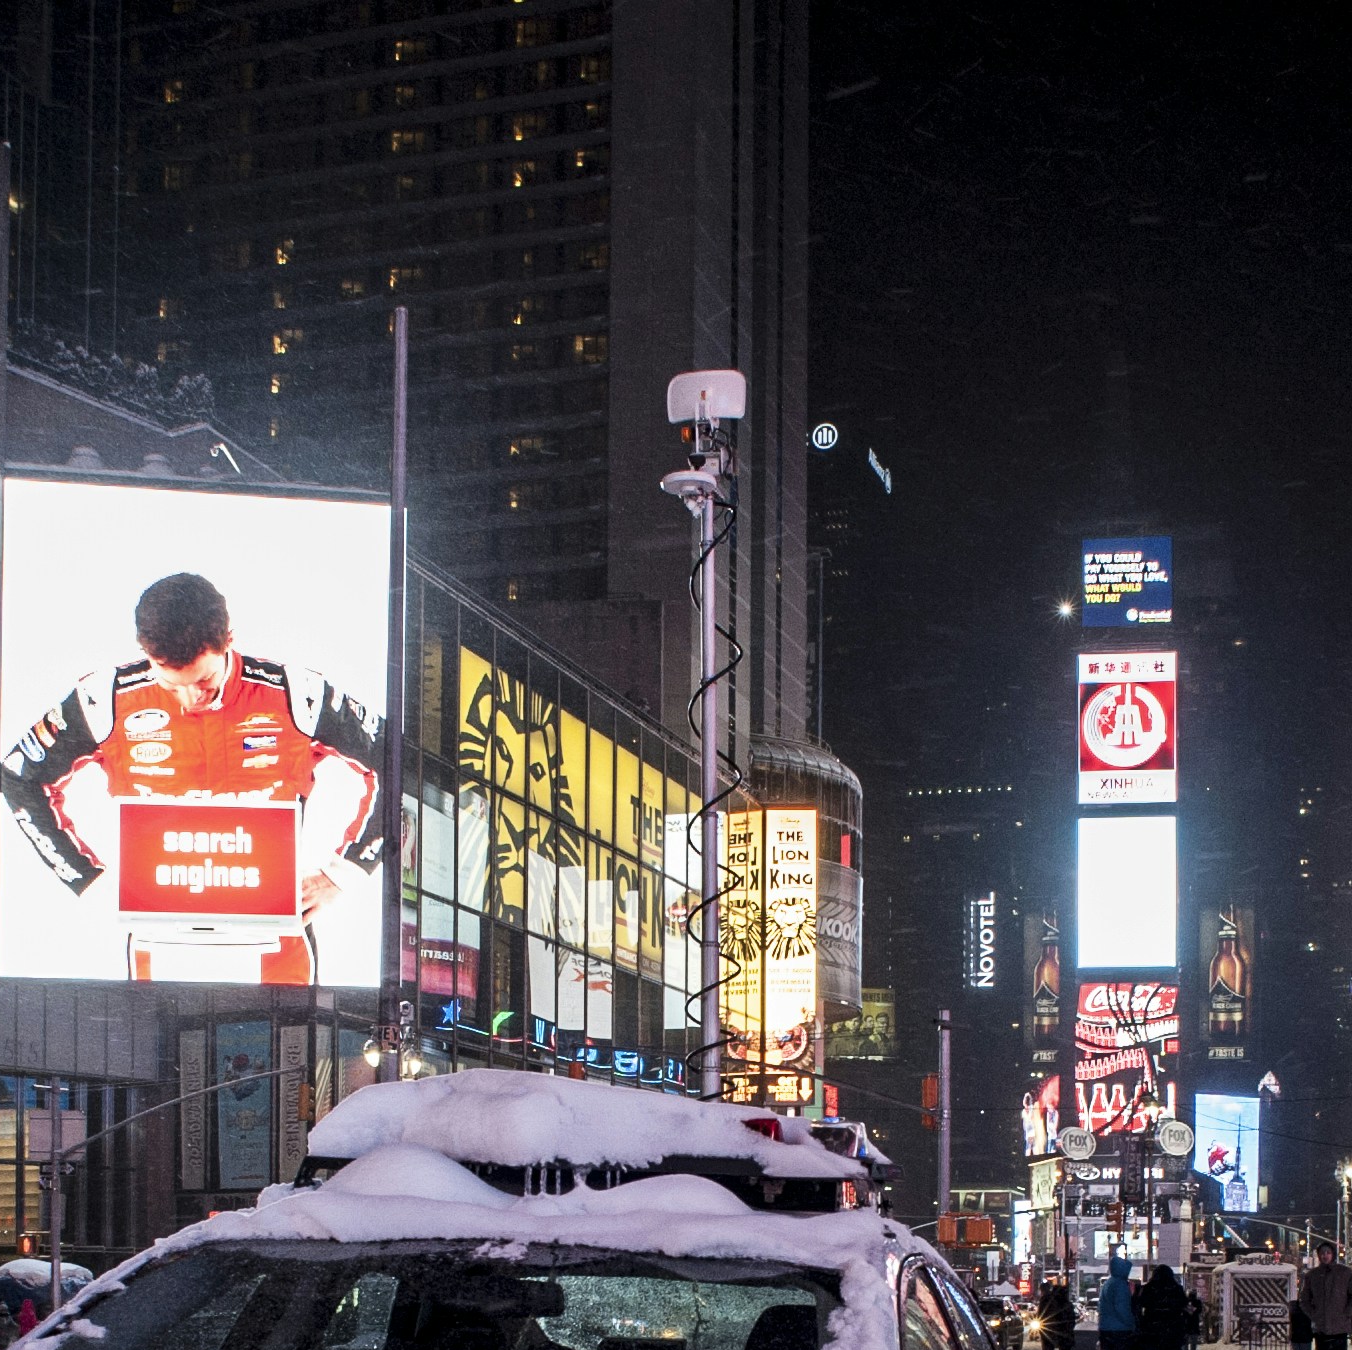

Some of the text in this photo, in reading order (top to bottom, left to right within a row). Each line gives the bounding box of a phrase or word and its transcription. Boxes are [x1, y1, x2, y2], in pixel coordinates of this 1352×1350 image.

[1094, 553, 1112, 563] YOU
[1125, 572, 1142, 582] YOU
[1085, 583, 1142, 593] WHAT WOULD
[1085, 593, 1103, 603] YOU
[1088, 660, 1164, 674] 新华通社
[631, 795, 662, 848] THE
[163, 826, 252, 854] search
[777, 831, 804, 841] THE
[772, 846, 809, 864] LION
[156, 858, 260, 894] engines
[770, 869, 813, 890] KING
[978, 892, 995, 987] NOVOTEL
[1069, 1135, 1088, 1147] FOX
[1167, 1130, 1186, 1141] FOX
